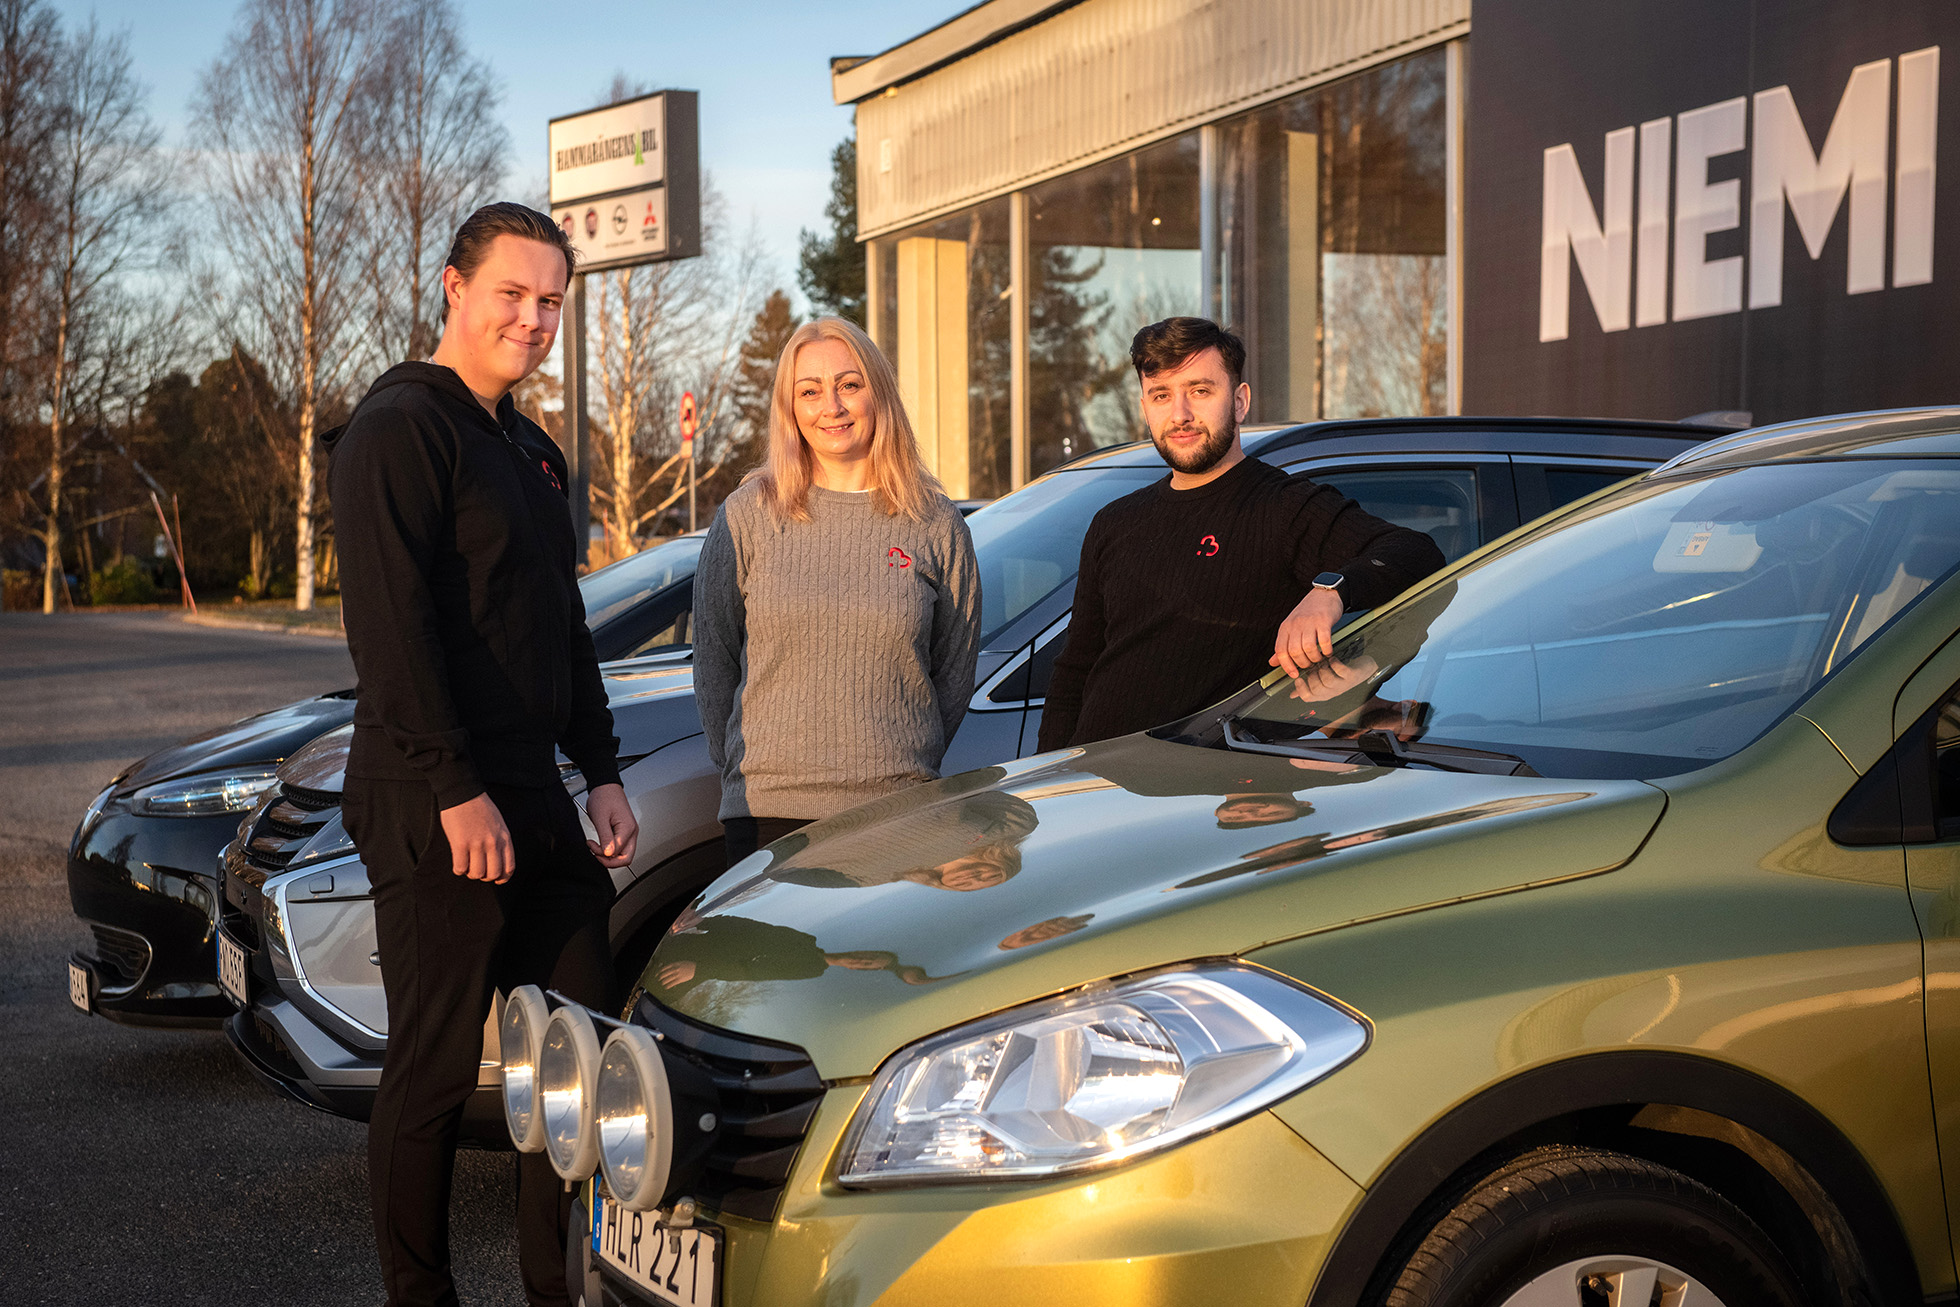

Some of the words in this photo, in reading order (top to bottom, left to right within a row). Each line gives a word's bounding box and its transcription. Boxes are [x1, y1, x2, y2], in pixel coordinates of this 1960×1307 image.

[642, 128, 658, 153] BIL
[1539, 44, 1940, 343] NIEMI
[605, 1203, 641, 1274] HLR
[649, 1219, 701, 1305] 221
